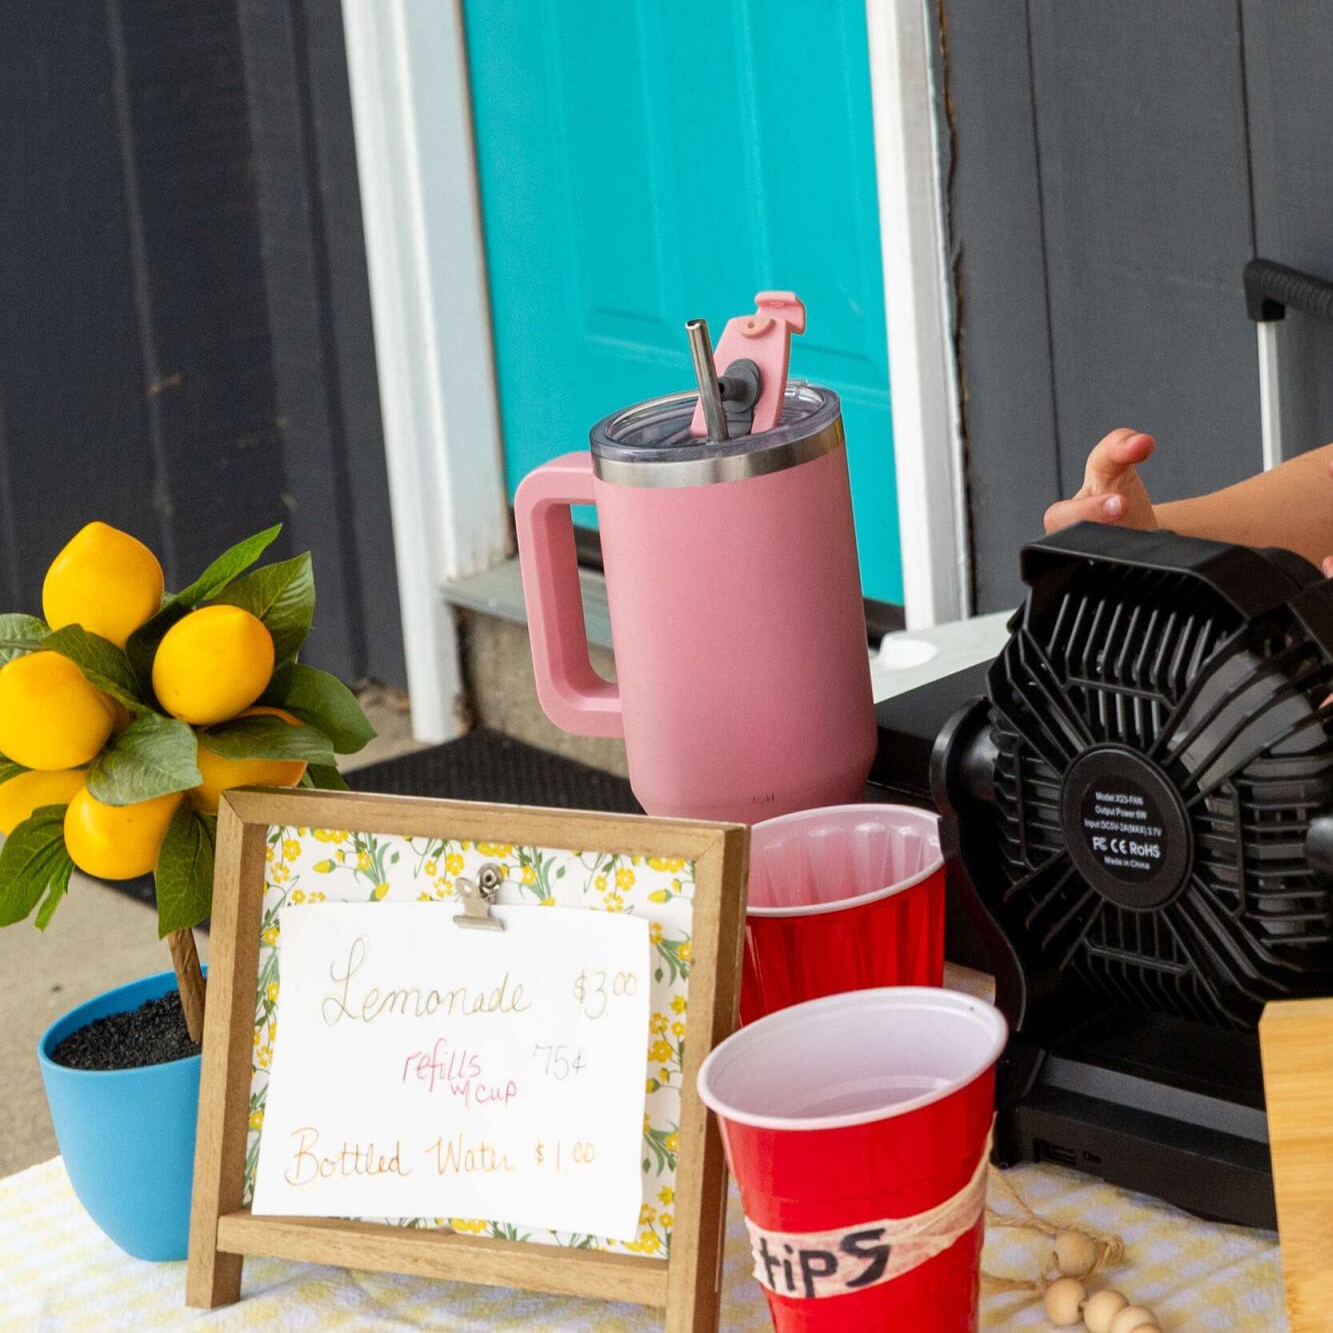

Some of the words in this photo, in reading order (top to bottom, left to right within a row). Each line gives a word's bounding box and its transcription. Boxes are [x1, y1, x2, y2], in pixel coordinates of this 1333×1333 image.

[1104, 855, 1122, 867] Made
[1130, 858, 1151, 870] China
[1129, 841, 1161, 859] RoHS
[321, 937, 532, 1027] Lemonade
[402, 1037, 482, 1093] refills
[285, 1127, 414, 1187] Bottled
[425, 1133, 517, 1176] Water
